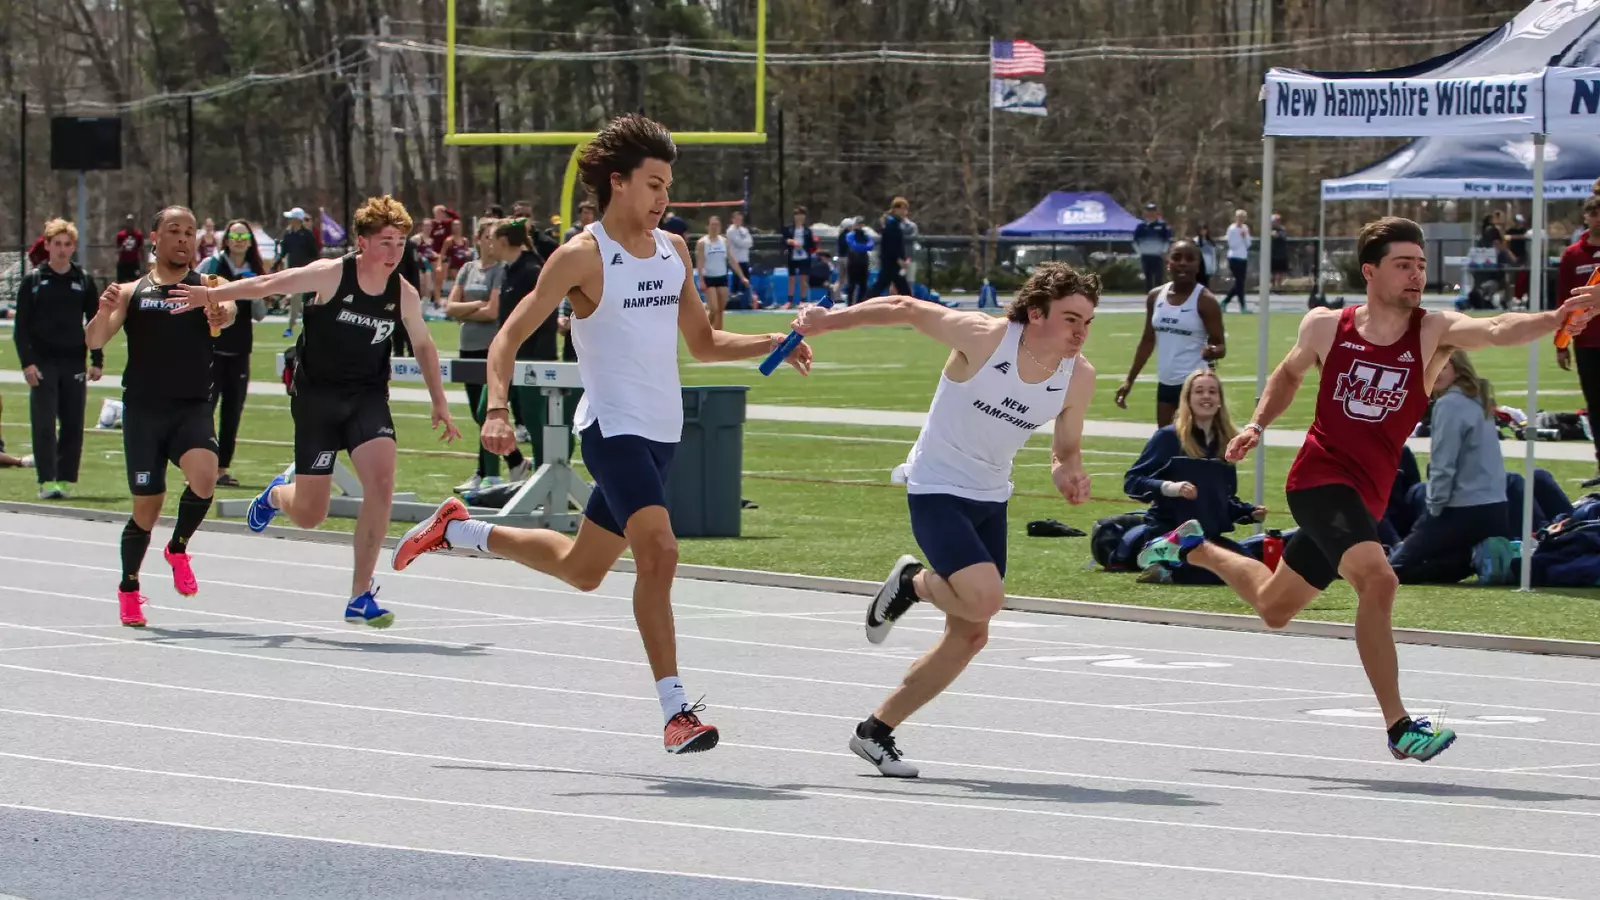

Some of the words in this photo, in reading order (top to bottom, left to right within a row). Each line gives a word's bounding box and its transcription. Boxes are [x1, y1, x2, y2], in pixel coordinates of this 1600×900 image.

[1276, 82, 1317, 116] New
[1322, 81, 1429, 123] Hampshire
[1436, 80, 1528, 116] Wildcats
[637, 280, 663, 291] NEW
[140, 299, 188, 309] BRYAN
[338, 310, 393, 329] BRYAN
[1001, 397, 1030, 414] NEW
[442, 504, 458, 518] new
[413, 517, 442, 543] balance
